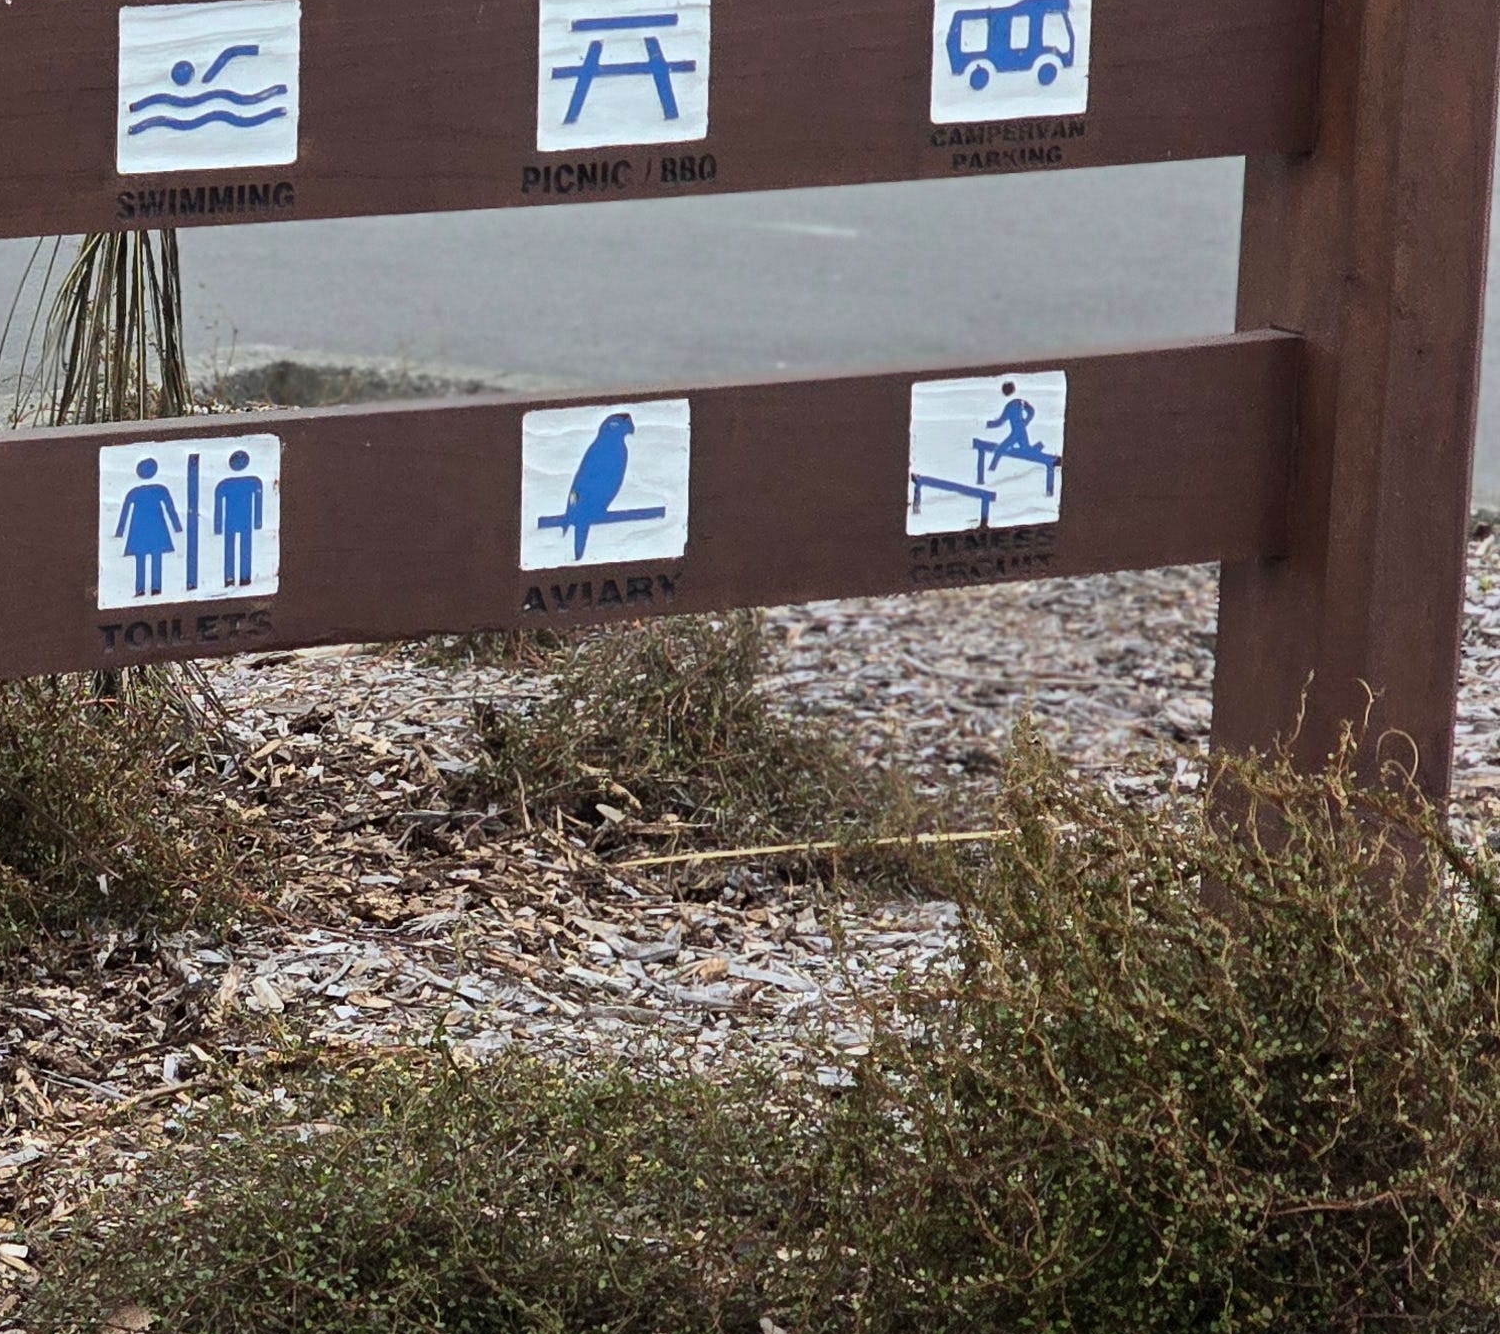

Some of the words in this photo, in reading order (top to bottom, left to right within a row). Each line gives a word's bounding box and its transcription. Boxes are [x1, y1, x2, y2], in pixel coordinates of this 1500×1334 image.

[930, 119, 1086, 147] CAMPERVAN
[520, 158, 632, 195] PICNIC
[951, 145, 1064, 170] PARKING
[116, 181, 295, 221] SWIMMING
[521, 571, 683, 615] AVIARY
[98, 610, 273, 652] TOILETS
